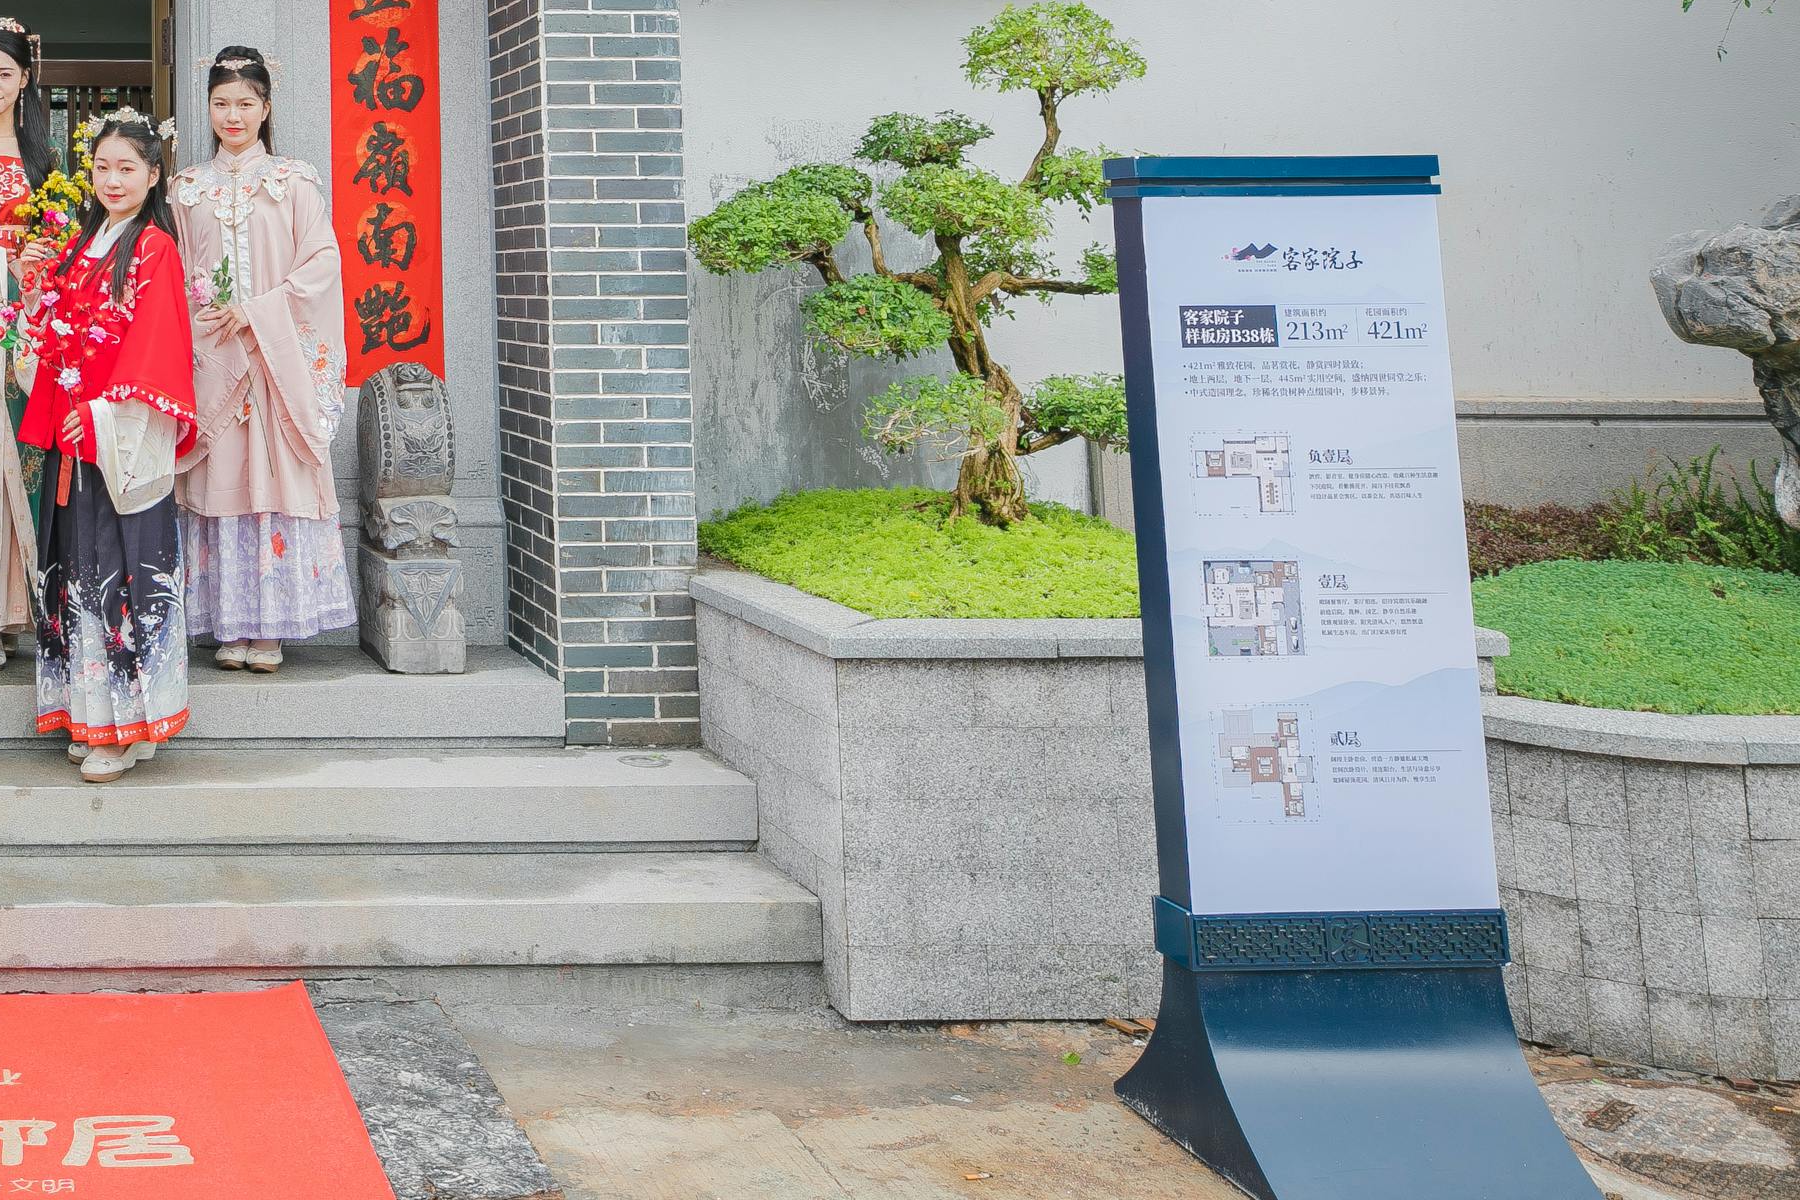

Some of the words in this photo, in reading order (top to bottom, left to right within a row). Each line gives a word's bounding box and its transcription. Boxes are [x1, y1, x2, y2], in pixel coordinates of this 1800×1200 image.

[1281, 246, 1364, 272] 客家院子
[1183, 308, 1245, 325] 客家院子
[1284, 307, 1327, 317] 建筑面积约
[1365, 307, 1408, 317] 花园面积约
[1185, 327, 1276, 345] 样板房B38栋
[1308, 448, 1354, 466] 负壹层
[1318, 574, 1349, 591] 壹层
[1329, 731, 1362, 749] 贰层
